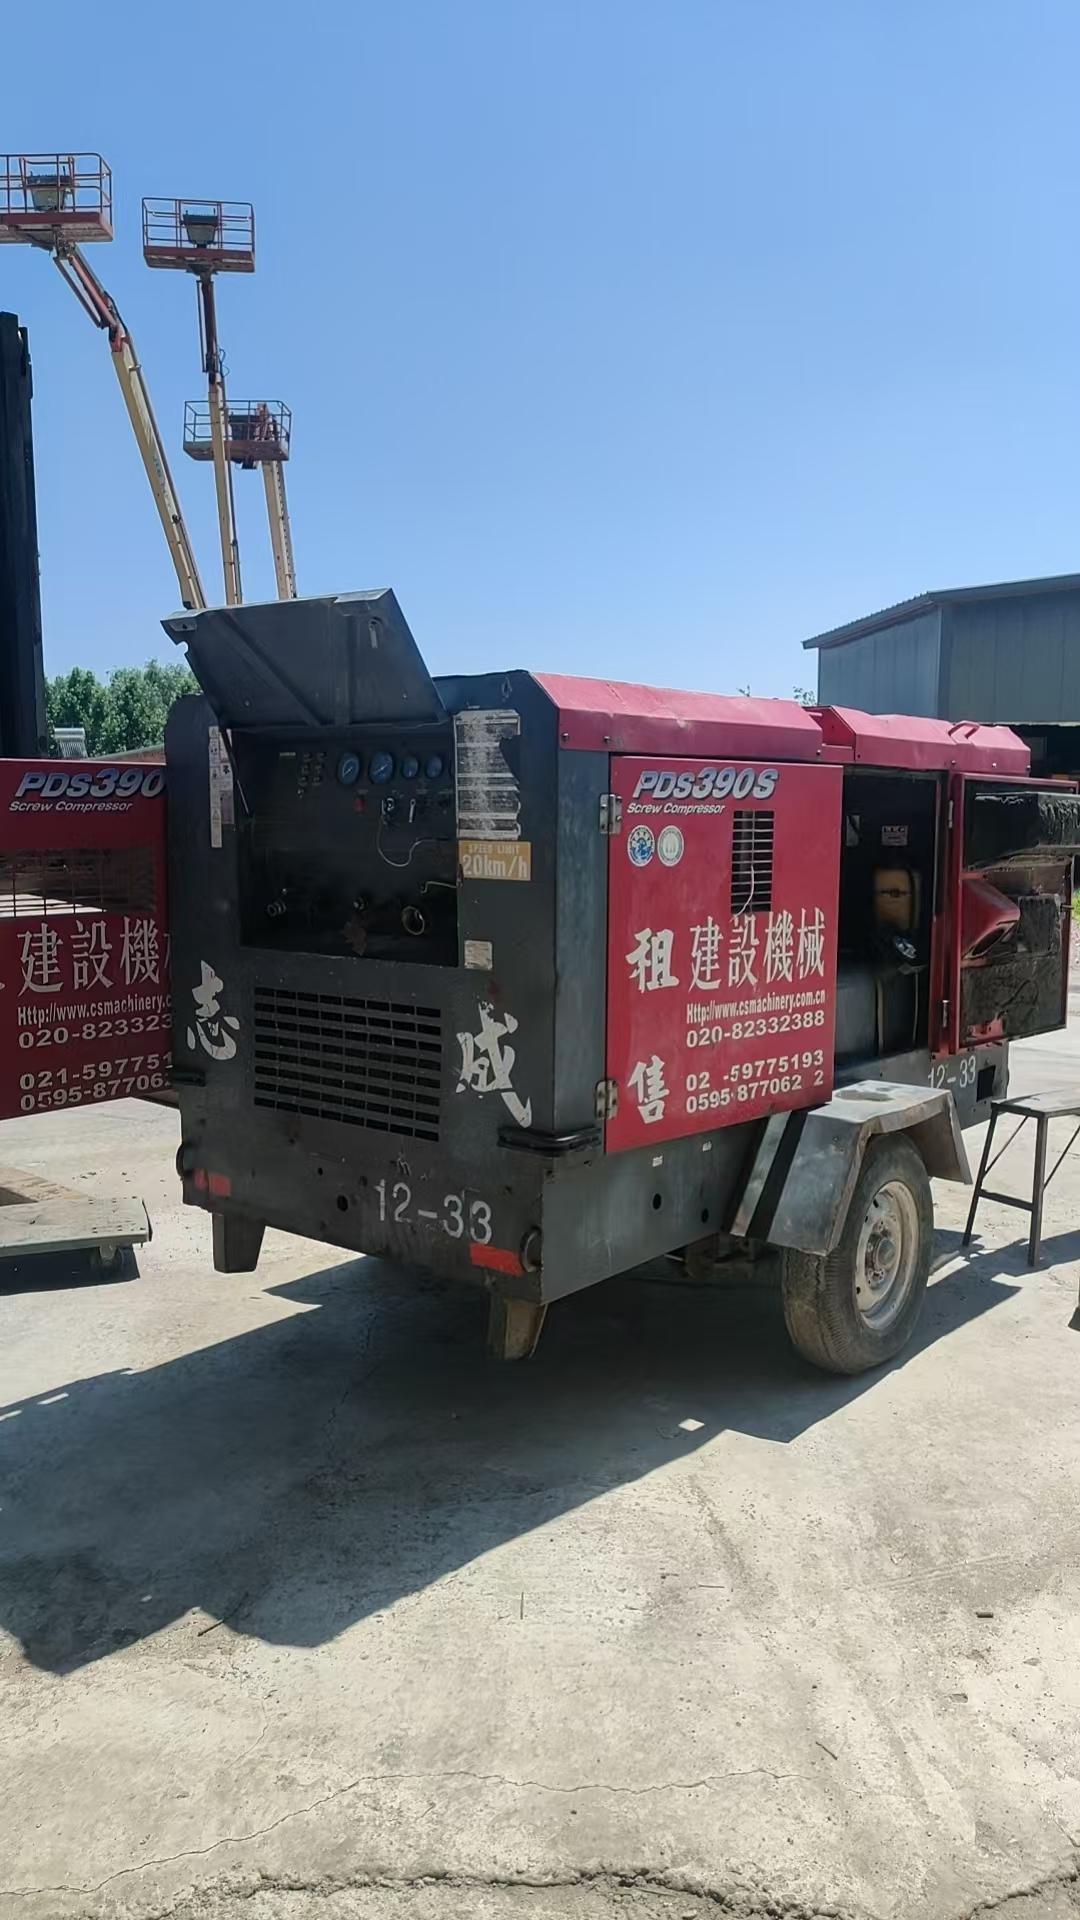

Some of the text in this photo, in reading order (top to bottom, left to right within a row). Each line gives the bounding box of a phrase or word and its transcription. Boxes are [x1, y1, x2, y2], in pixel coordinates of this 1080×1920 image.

[632, 766, 779, 799] PDS390S
[9, 801, 133, 813] Screw Compressor
[627, 802, 725, 815] Screw Compressor
[462, 853, 528, 878] 20km/h
[17, 916, 171, 997] 建設機
[688, 907, 826, 993] 建設機械
[686, 989, 826, 1026] Http://www.csmachinery.com.cn
[18, 1013, 173, 1048] 020-823323
[686, 1010, 825, 1048] 020-82332388
[627, 1054, 670, 1125] 售
[928, 1055, 976, 1089] 12-33
[374, 1179, 493, 1245] 12-33
